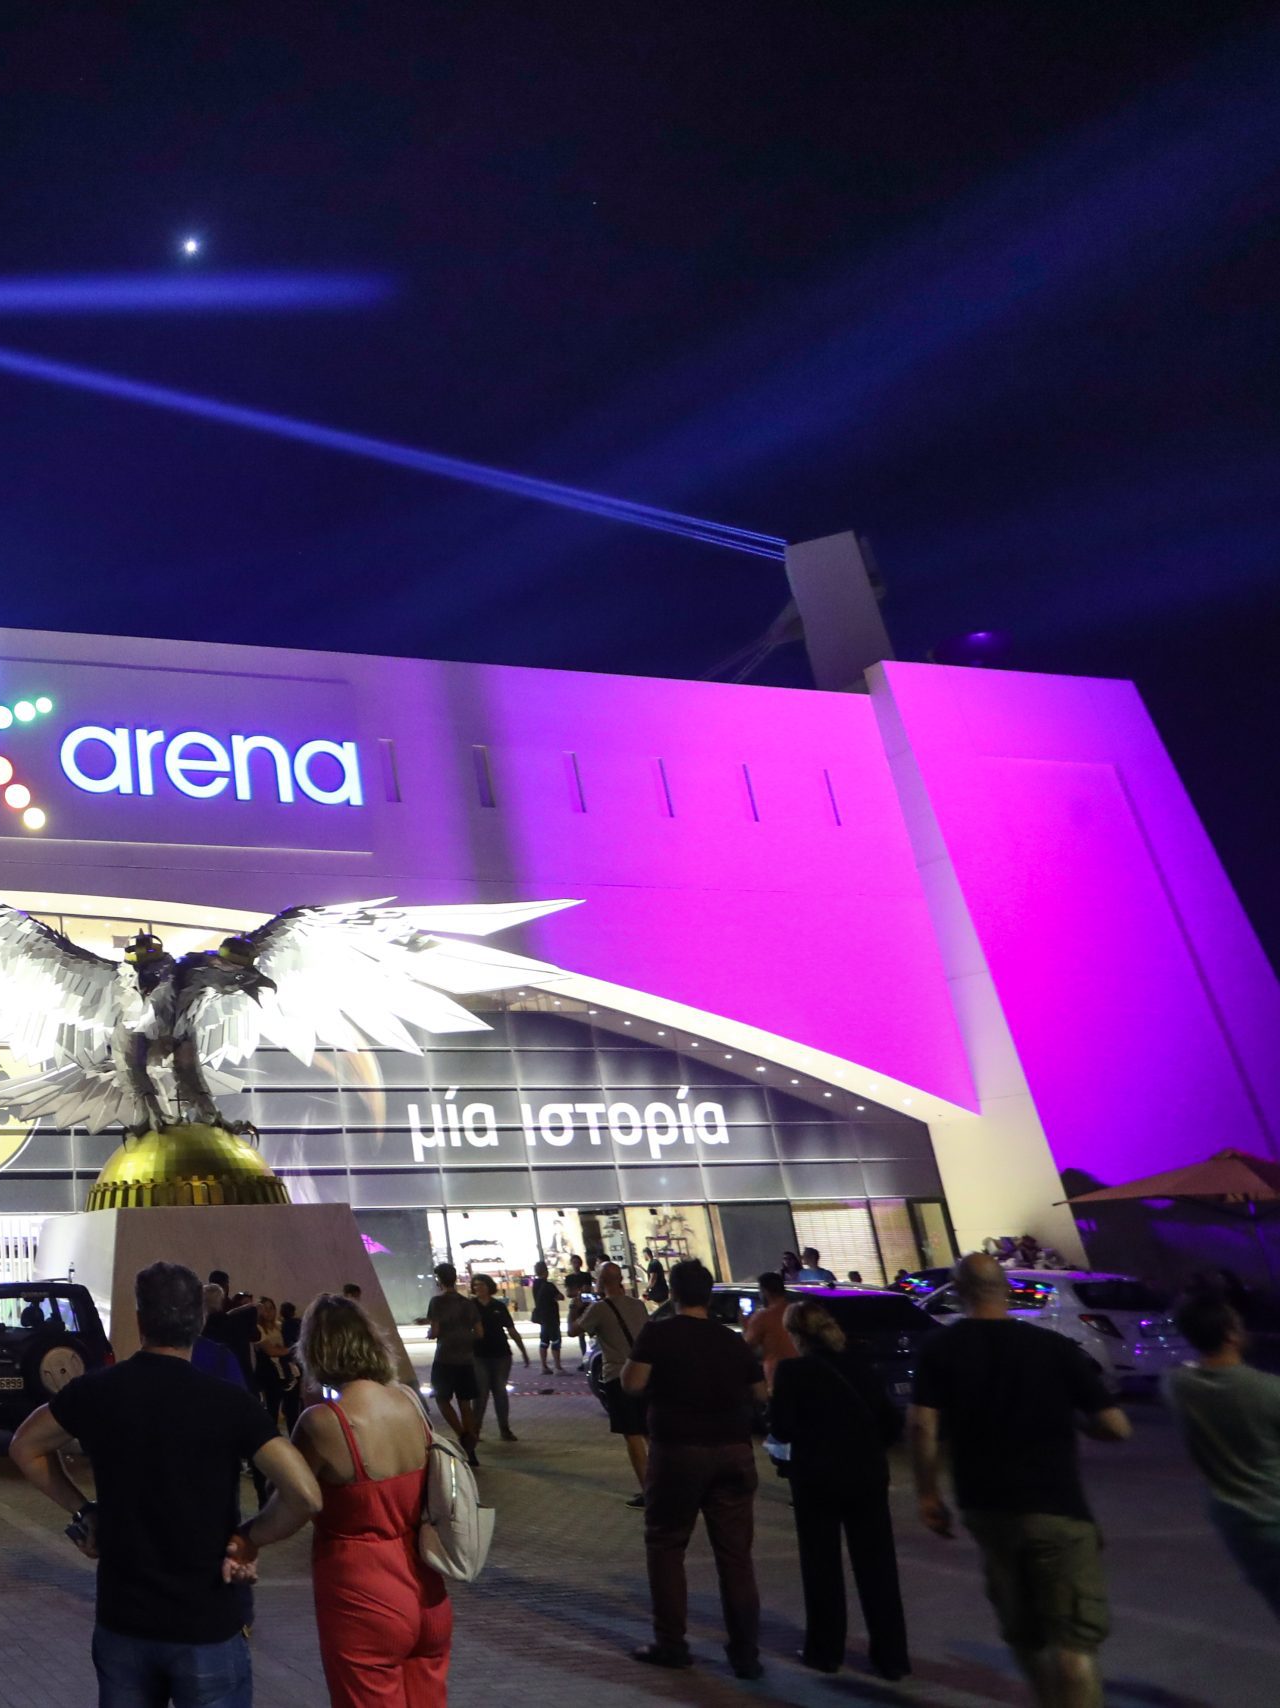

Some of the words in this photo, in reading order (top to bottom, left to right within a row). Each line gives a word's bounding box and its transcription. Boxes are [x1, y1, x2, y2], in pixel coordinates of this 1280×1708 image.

[60, 725, 364, 806] arena
[407, 1085, 500, 1163] μία
[520, 1085, 730, 1160] ιστορία
